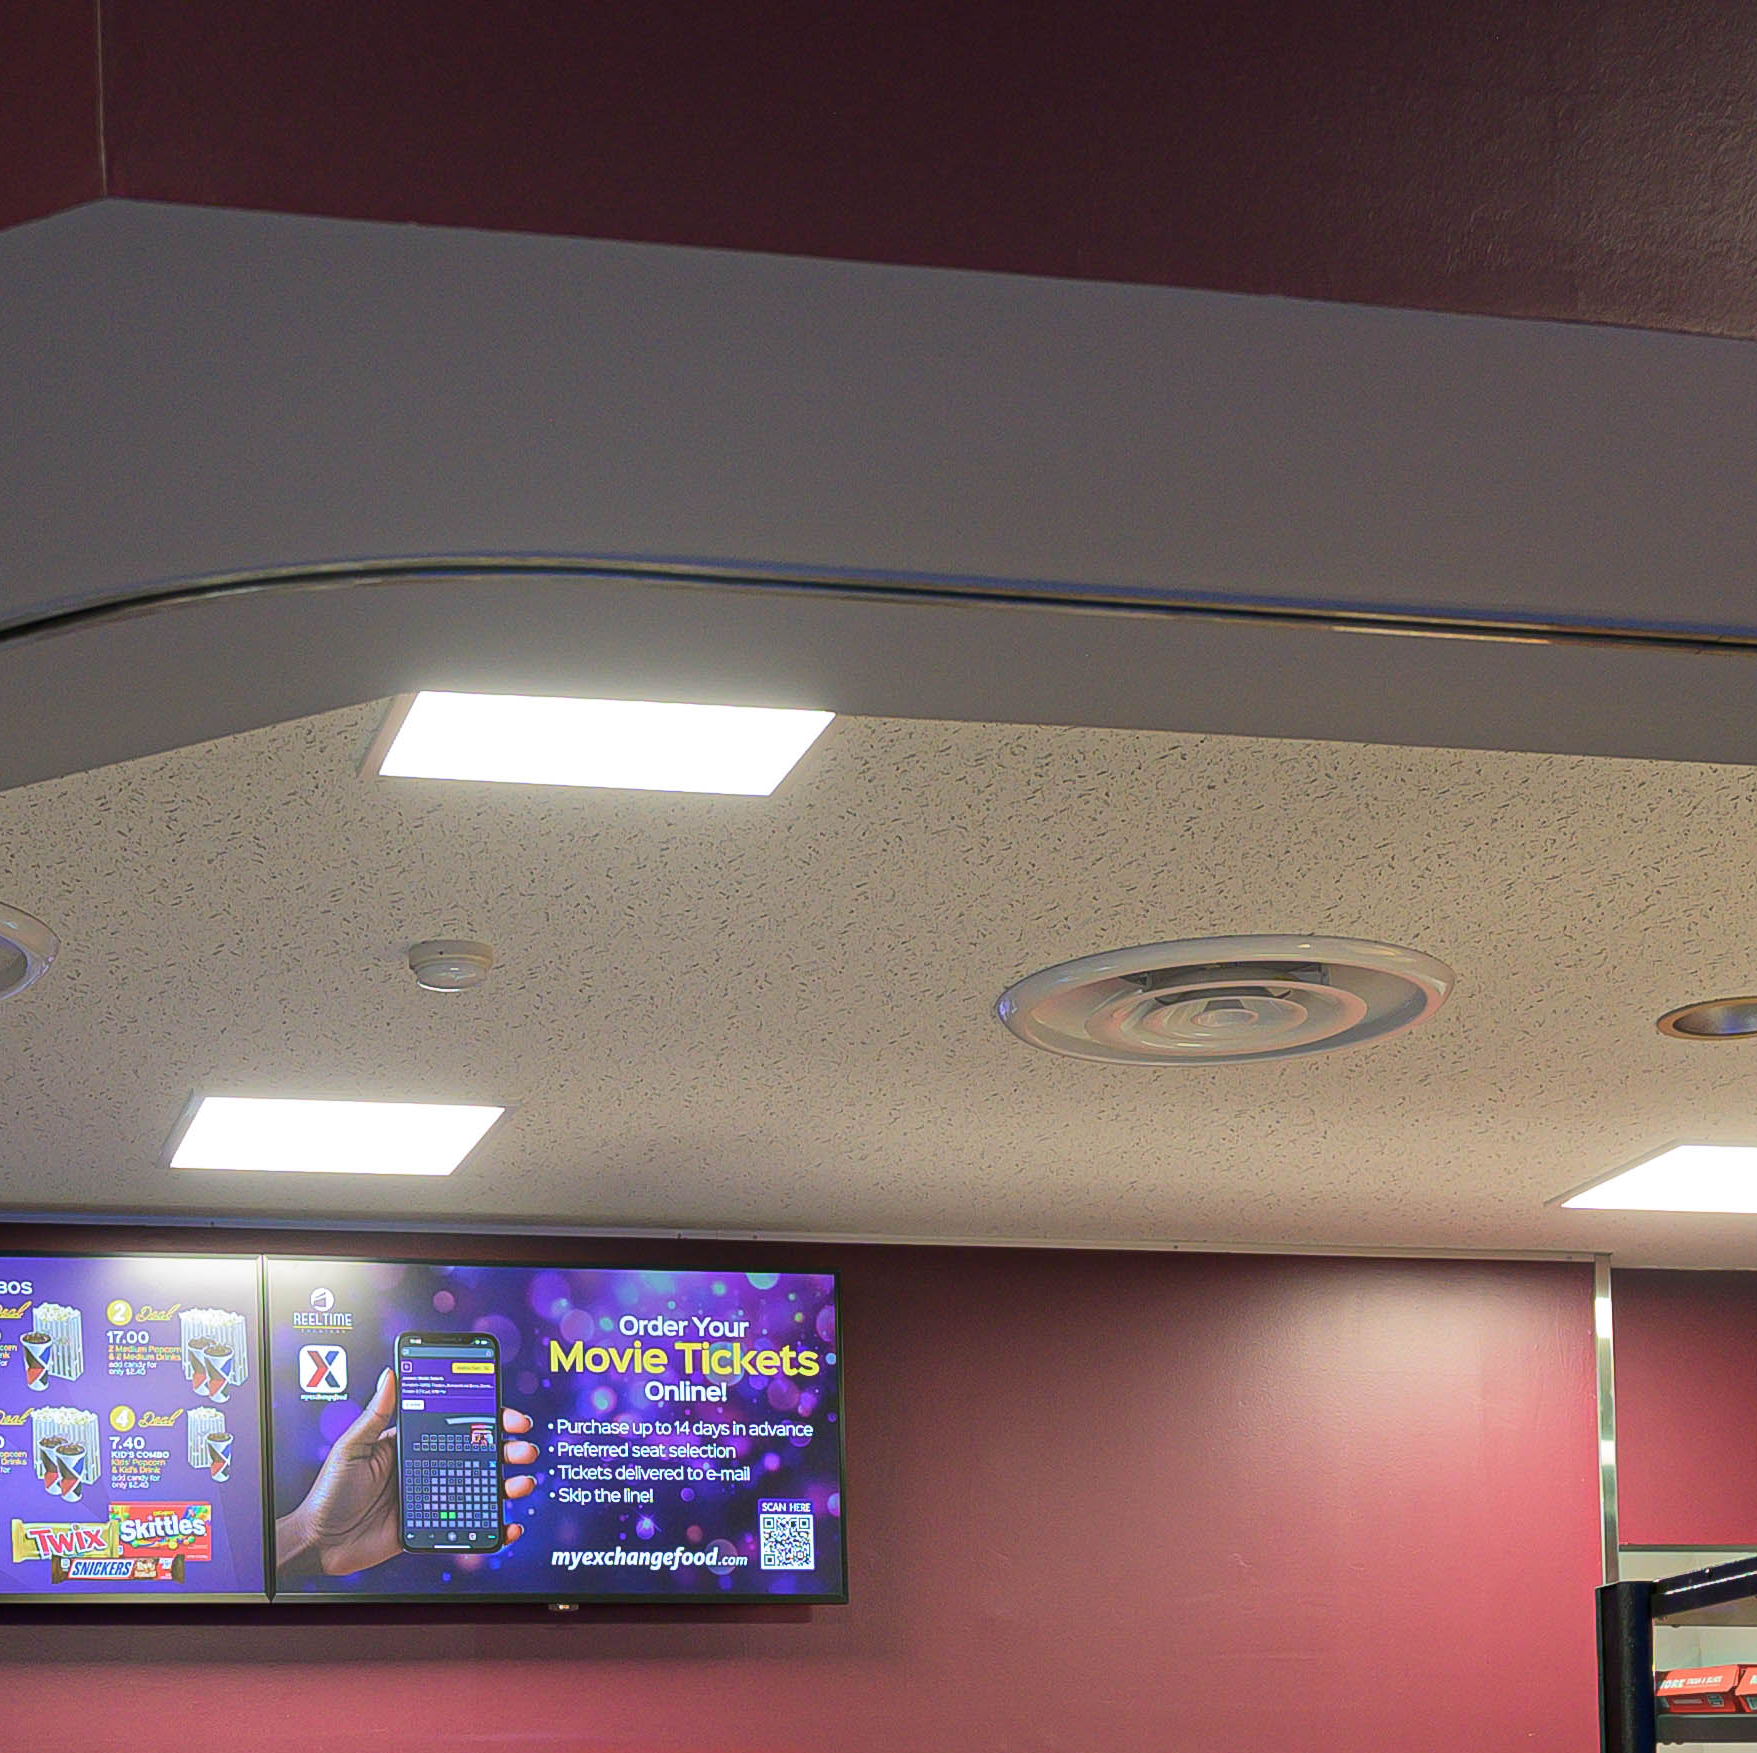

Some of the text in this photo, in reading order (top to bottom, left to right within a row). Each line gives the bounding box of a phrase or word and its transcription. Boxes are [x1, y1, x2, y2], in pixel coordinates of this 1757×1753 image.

[113, 1302, 126, 1322] 2
[619, 1316, 749, 1337] Order Your
[107, 1331, 150, 1344] 17.00
[550, 1341, 820, 1376] Movie Tickets
[645, 1381, 727, 1402] Online!
[115, 1409, 129, 1428] 4
[557, 1419, 813, 1439] Purchase up to 14 days in advance
[109, 1436, 145, 1450] 7.40
[557, 1443, 736, 1459] Preferred seat selection
[558, 1465, 750, 1481] Tickets delivered to e-mail
[559, 1488, 654, 1505] Skip the line!
[762, 1503, 811, 1512] SCAN HERE
[120, 1514, 207, 1541] Skittles
[28, 1524, 108, 1557] Twix
[72, 1560, 132, 1577] SNICKERS
[552, 1547, 748, 1571] myexchangefood.com
